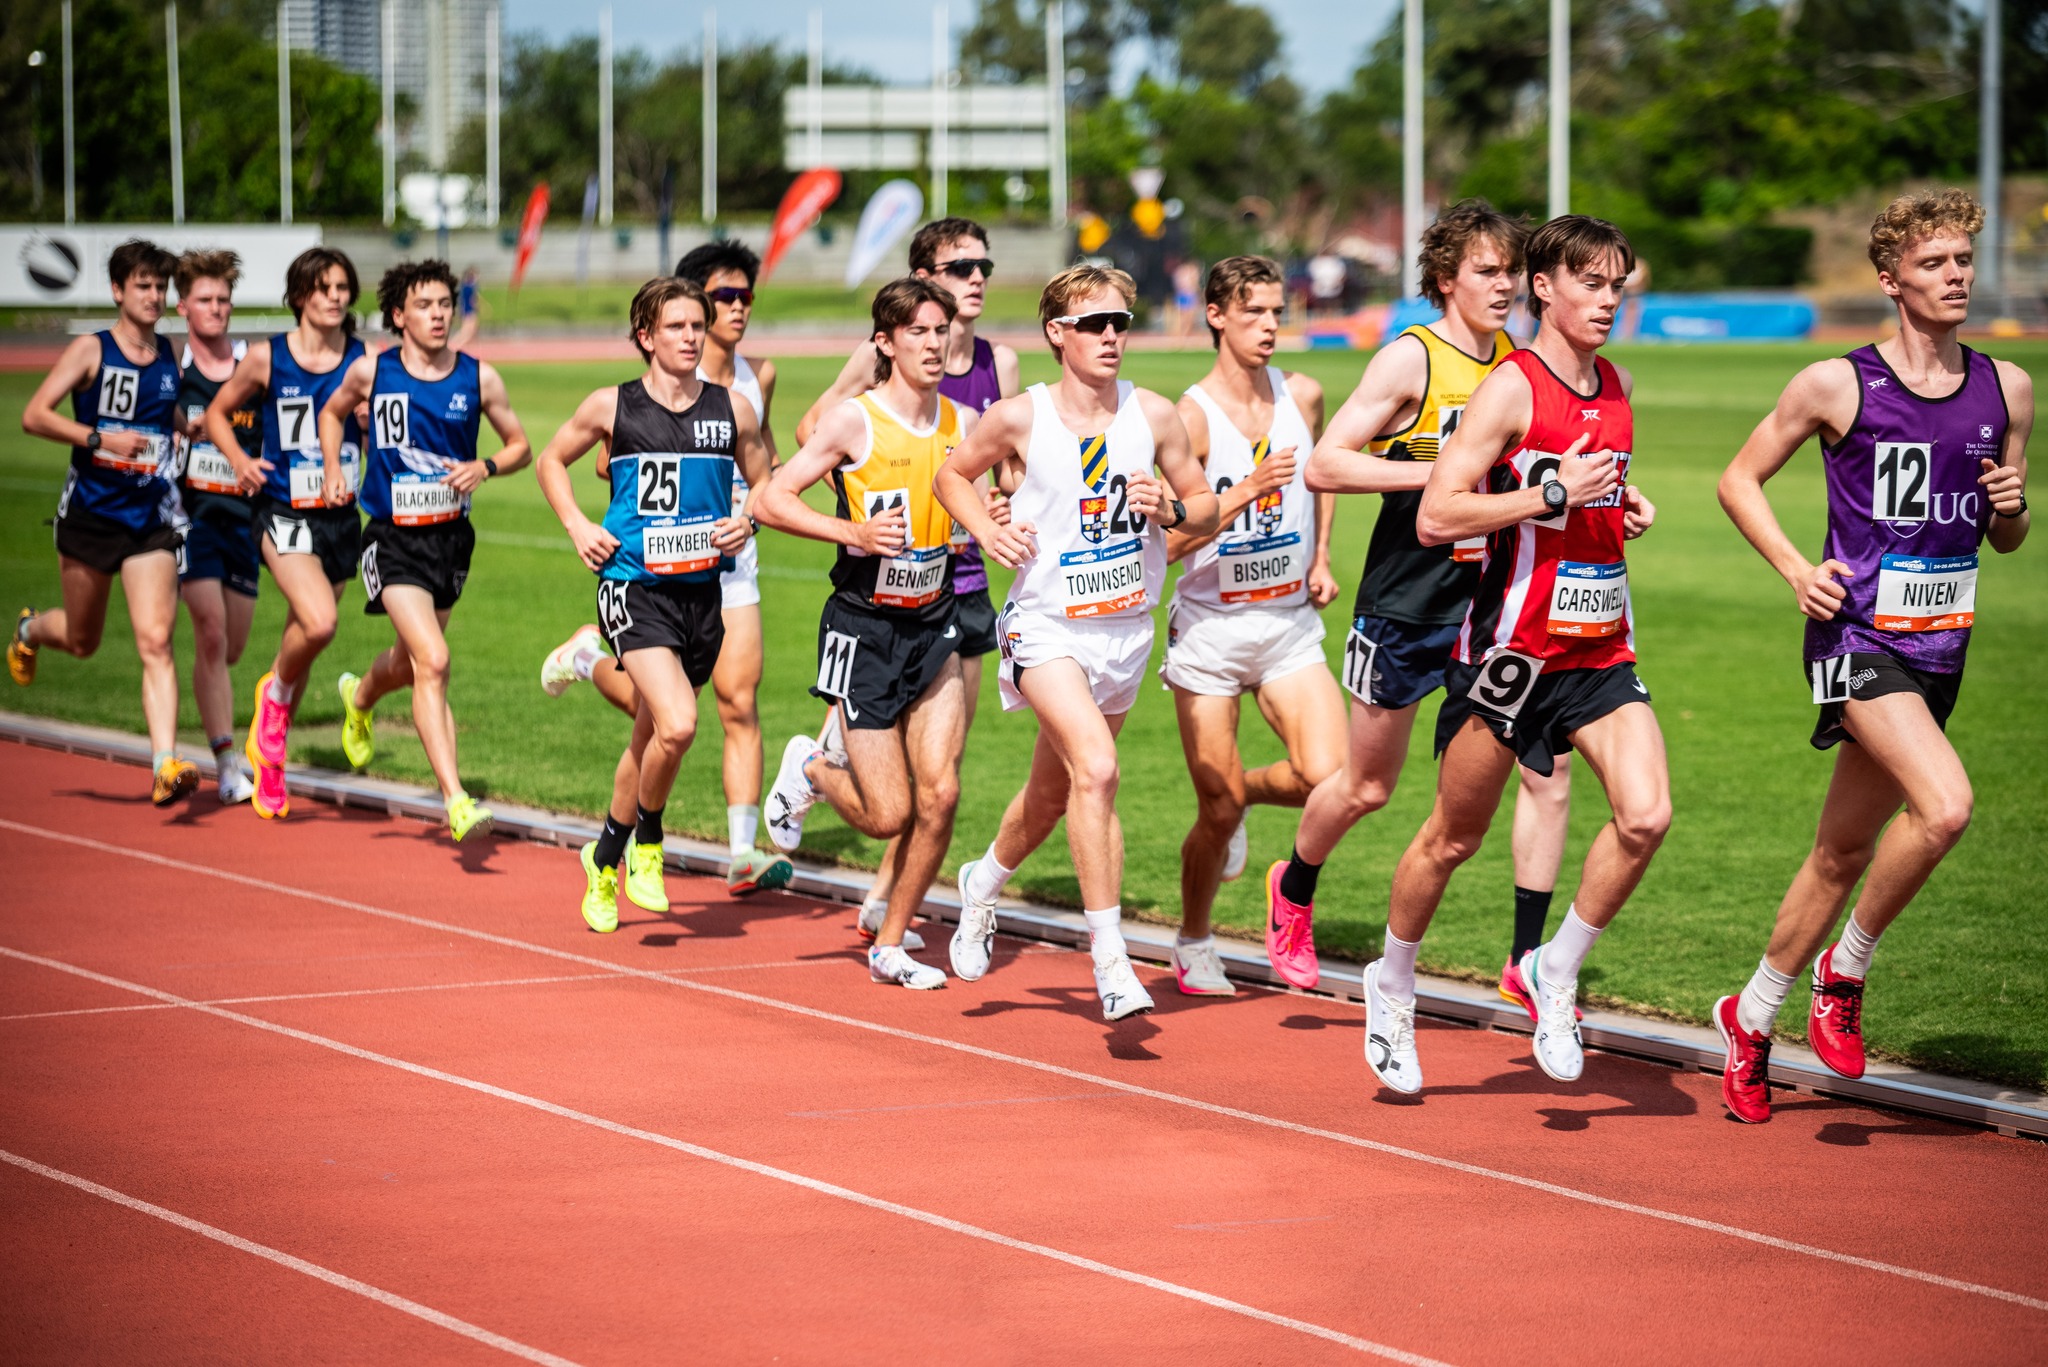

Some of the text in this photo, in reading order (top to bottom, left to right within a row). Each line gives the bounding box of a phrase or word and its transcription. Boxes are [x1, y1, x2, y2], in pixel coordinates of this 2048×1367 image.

[105, 373, 134, 415] 15
[282, 404, 309, 443] 7
[377, 399, 405, 443] 19
[694, 420, 732, 439] UTS
[695, 439, 731, 449] SPORT
[890, 458, 911, 468] VALOUR
[1878, 446, 1927, 517] 12
[396, 490, 459, 508] BLACKBURN
[639, 461, 678, 511] 25
[886, 564, 942, 589] BENNETT
[1066, 561, 1142, 596] TOWNSEND
[1234, 555, 1290, 583] BISHOP
[601, 582, 627, 633] 25
[1557, 585, 1624, 613] CARSWELL
[1903, 582, 1958, 607] NIVEN
[826, 636, 851, 695] 11
[1346, 634, 1373, 695] 17
[1479, 655, 1532, 707] 9
